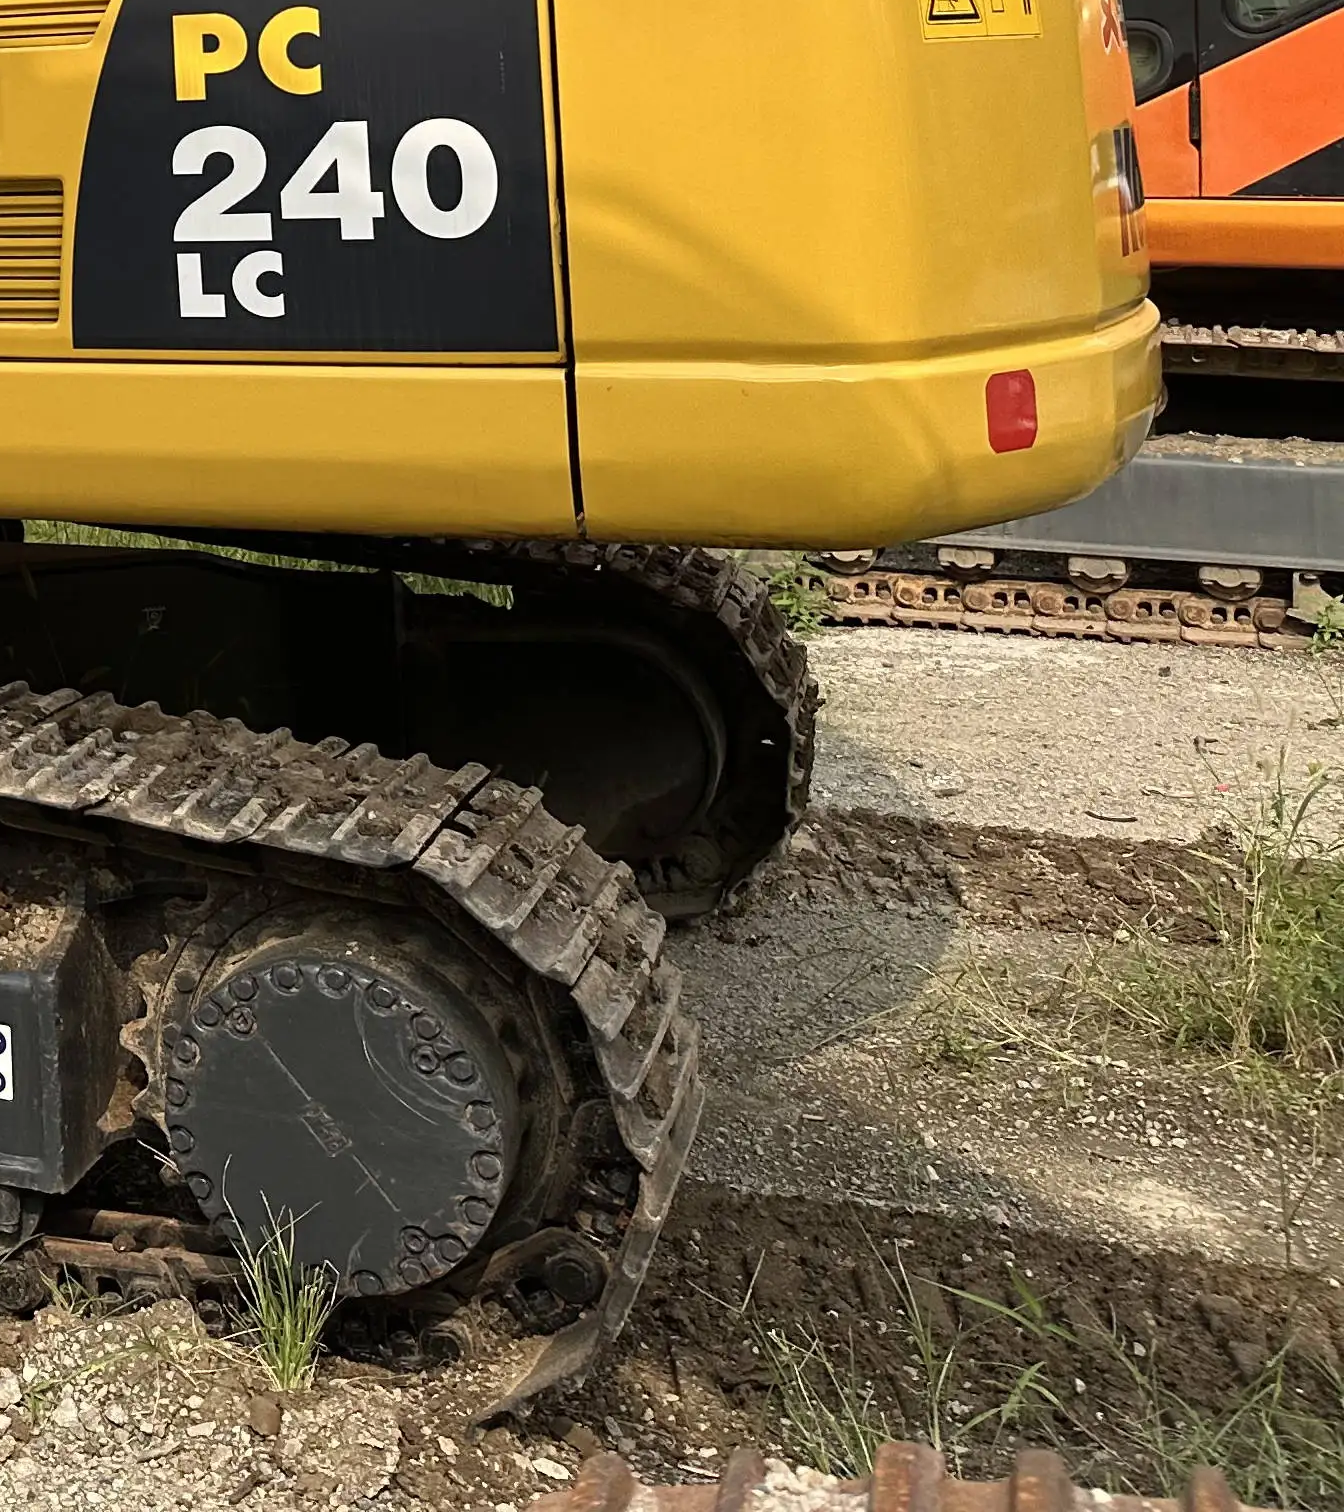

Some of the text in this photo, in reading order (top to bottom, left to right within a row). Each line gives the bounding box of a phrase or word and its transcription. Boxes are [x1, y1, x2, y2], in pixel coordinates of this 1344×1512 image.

[172, 6, 322, 102] PC
[172, 117, 499, 242] 240
[176, 250, 286, 318] LC
